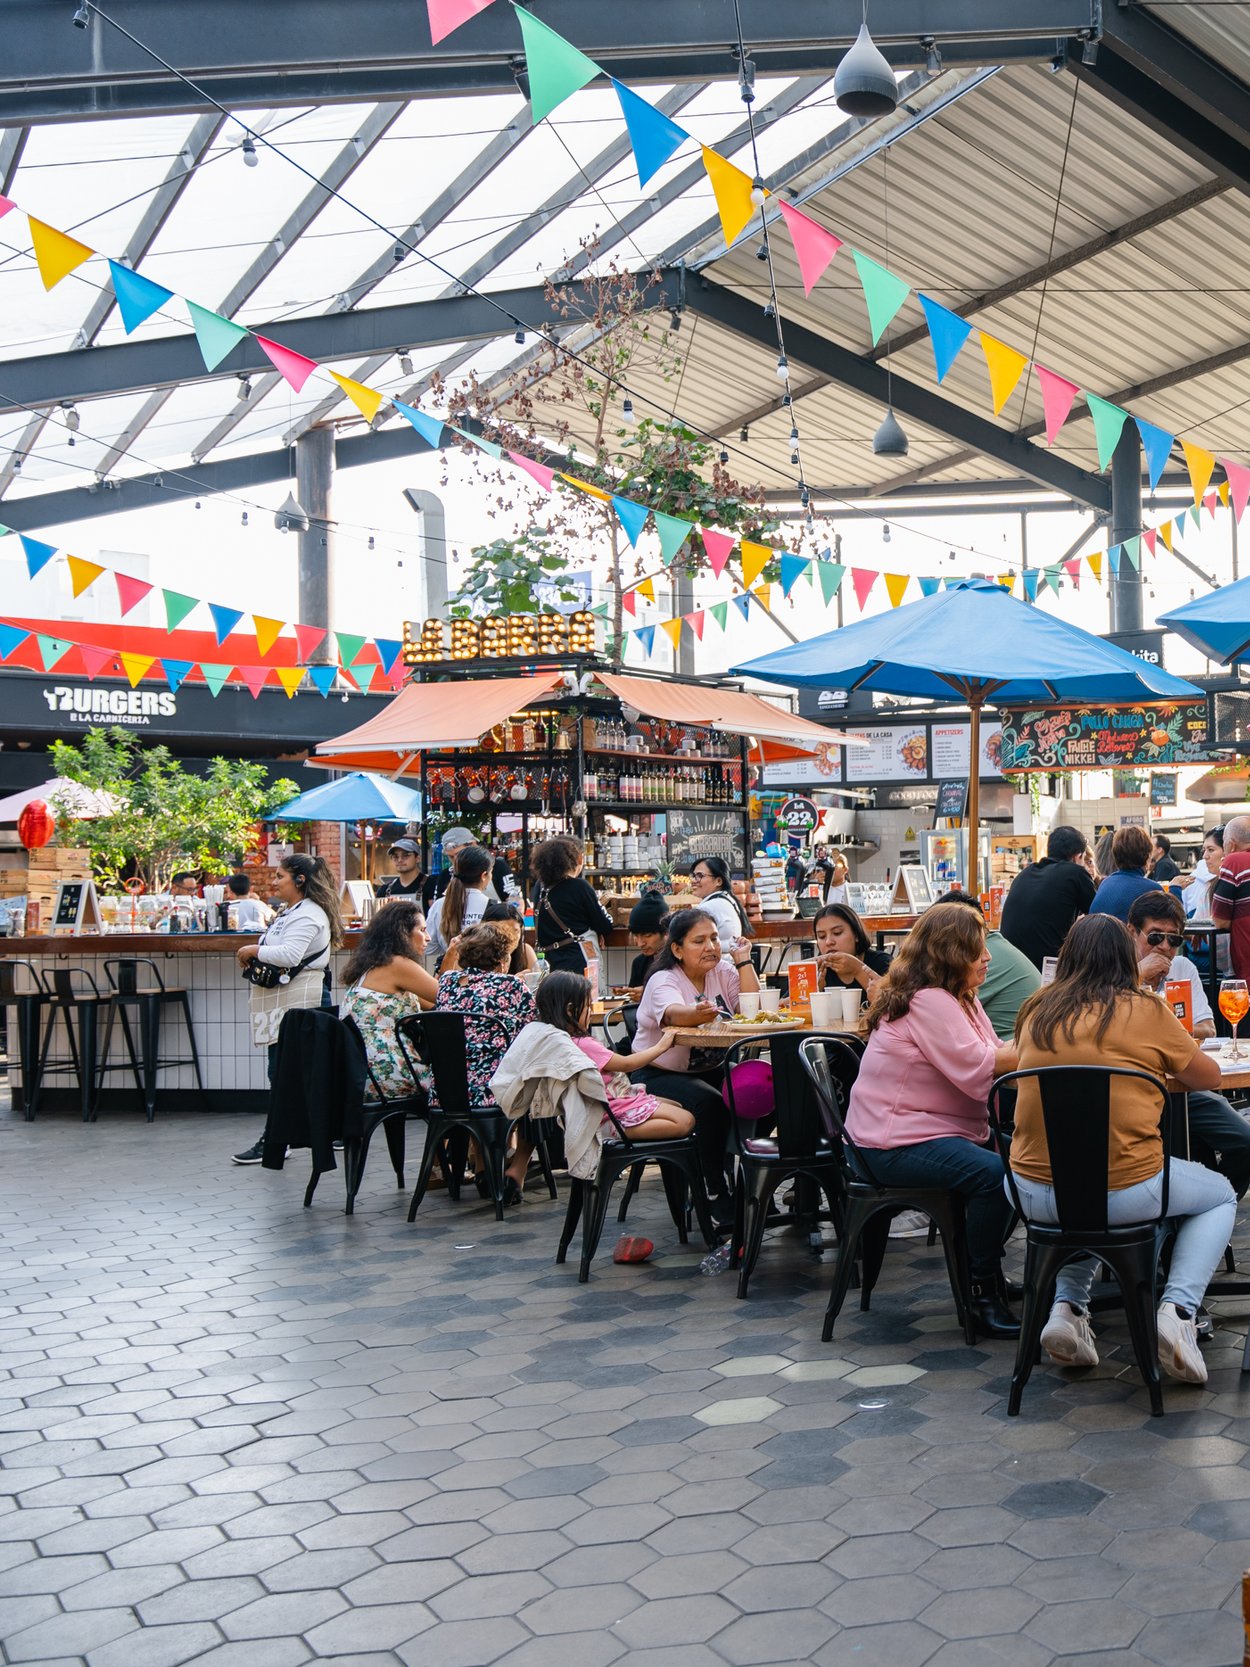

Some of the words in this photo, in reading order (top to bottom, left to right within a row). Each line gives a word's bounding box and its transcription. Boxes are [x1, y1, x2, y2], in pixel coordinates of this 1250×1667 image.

[402, 618, 444, 663] LA
[451, 610, 597, 660] BARRA
[43, 686, 177, 716] BURGERS
[79, 713, 92, 722] LA
[93, 713, 150, 724] CARNICERIA
[1064, 753, 1096, 765] NIKKEI
[793, 802, 805, 810] LA
[787, 811, 811, 826] 22
